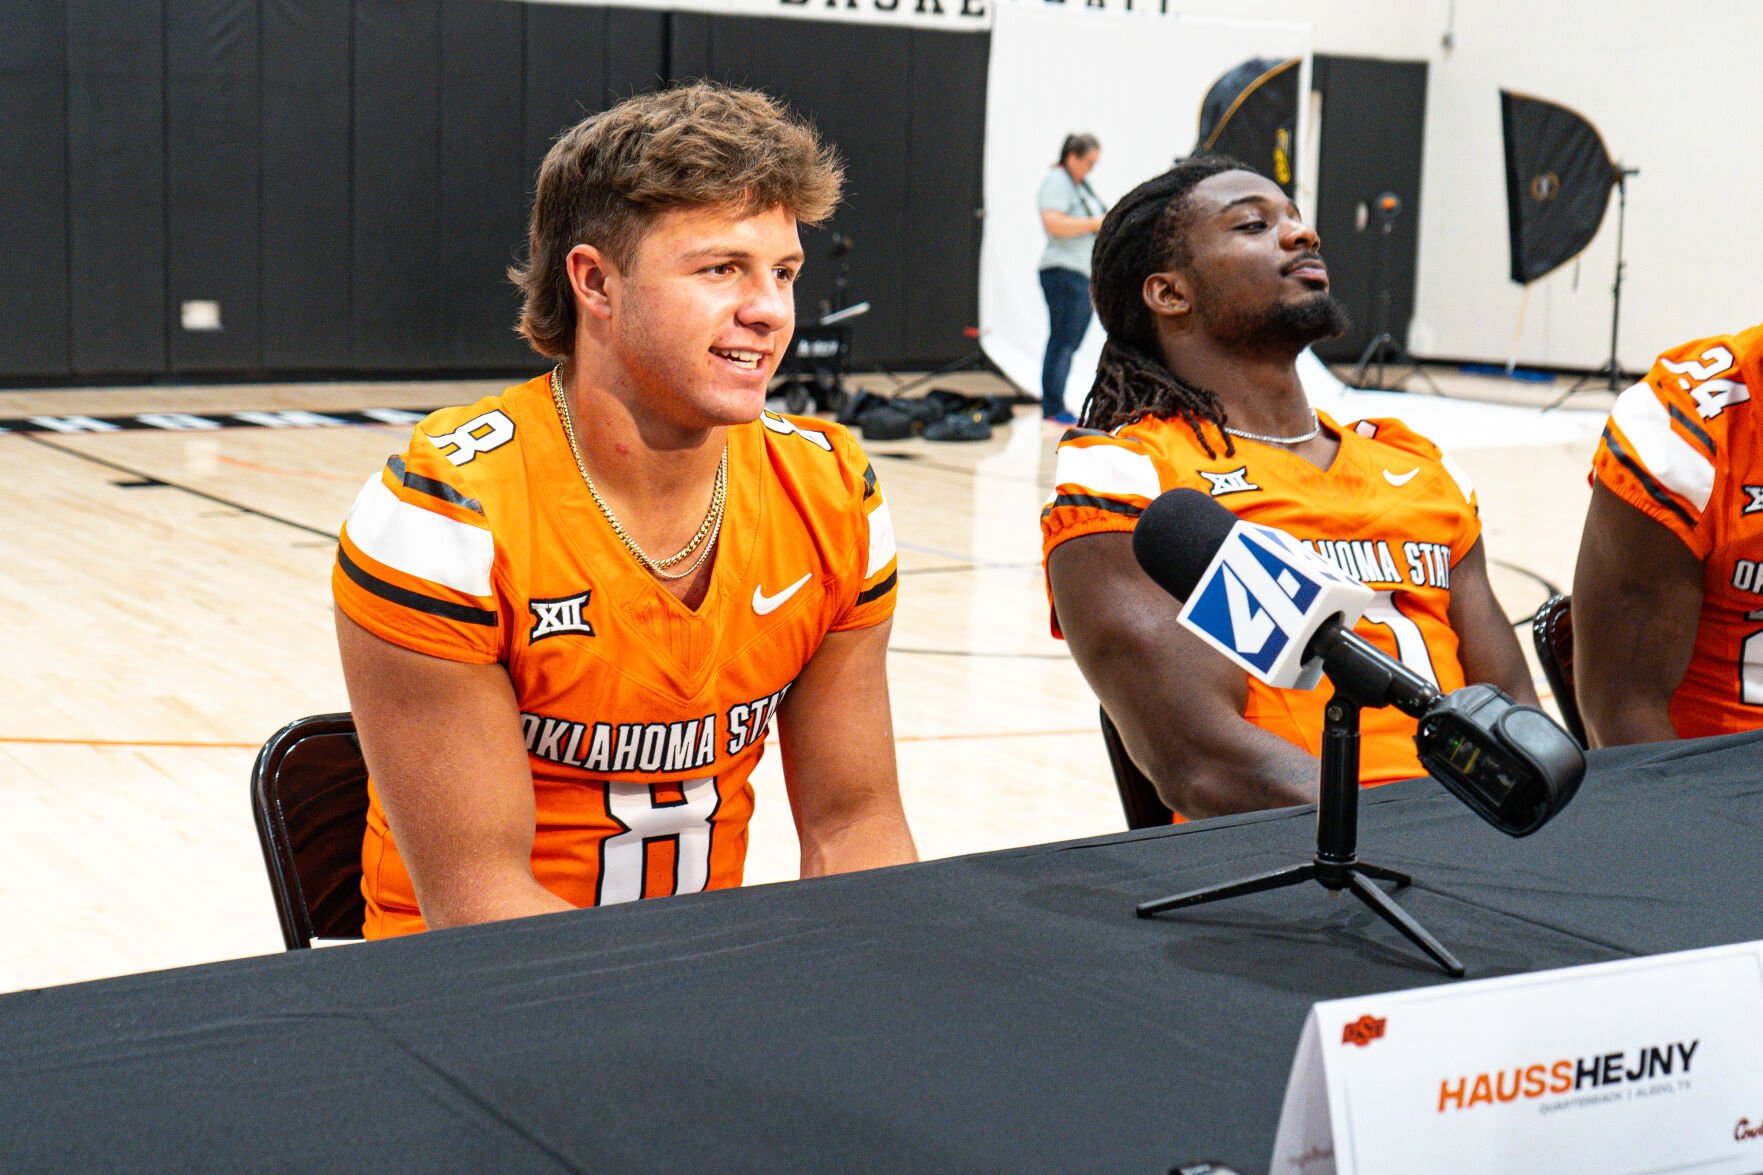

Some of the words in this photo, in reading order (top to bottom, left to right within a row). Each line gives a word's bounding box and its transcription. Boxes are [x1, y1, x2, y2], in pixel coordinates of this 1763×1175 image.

[1201, 467, 1261, 495] XII
[529, 591, 594, 643] XII
[520, 711, 717, 773] OKLAHOMA
